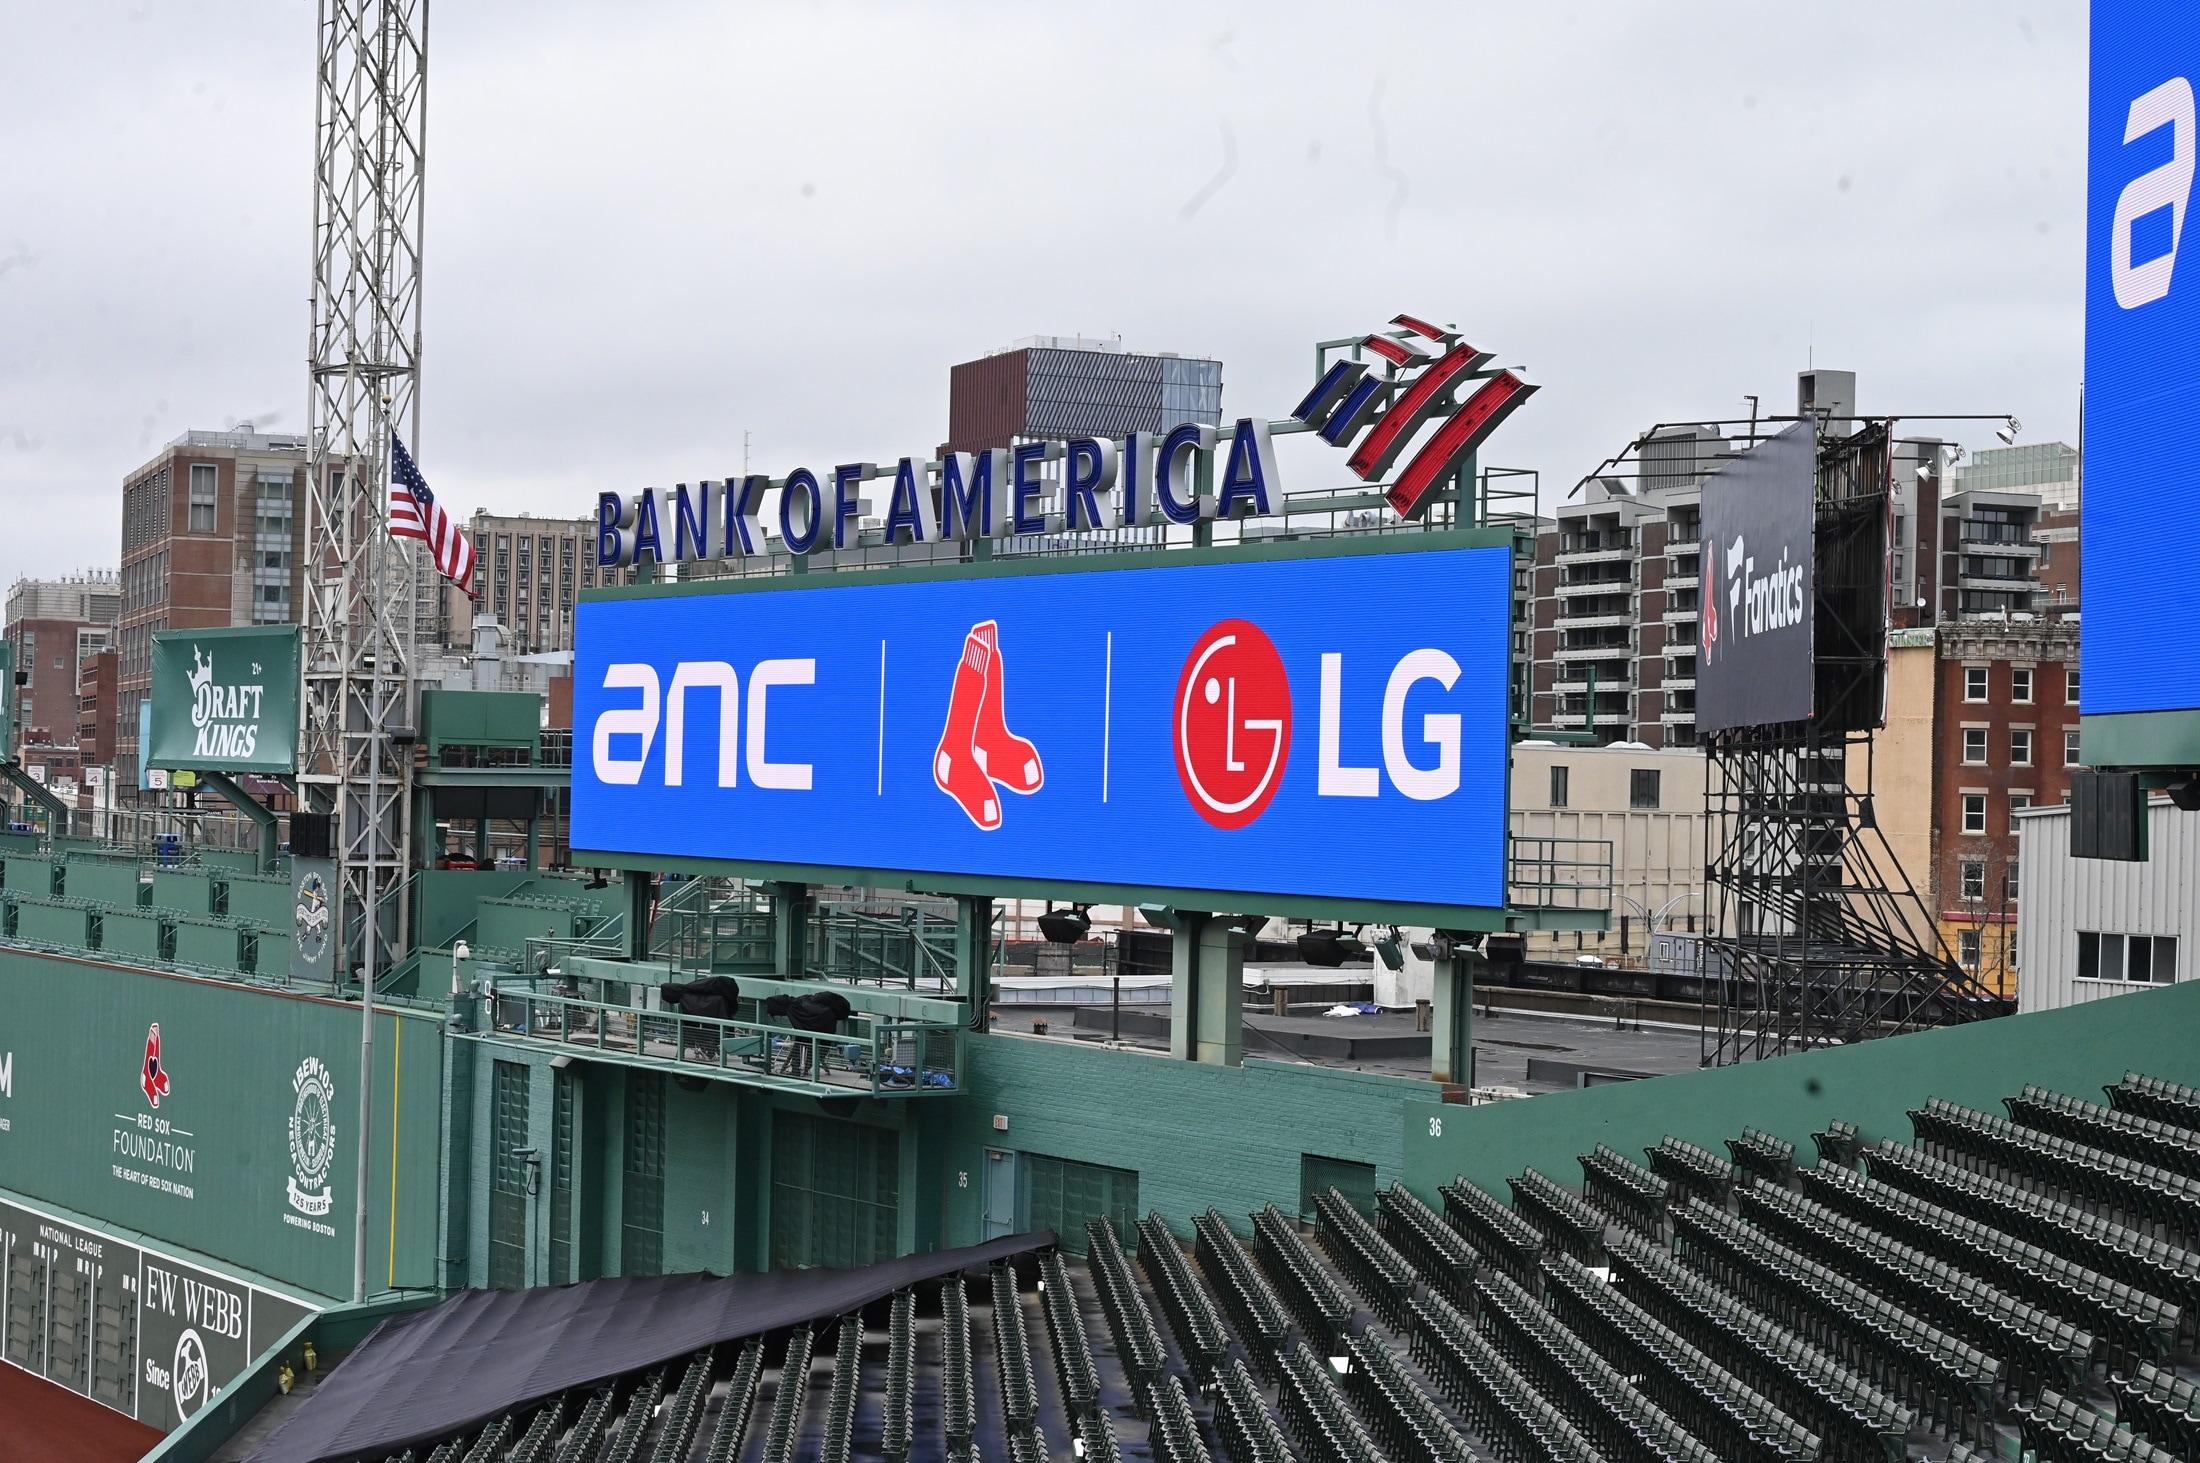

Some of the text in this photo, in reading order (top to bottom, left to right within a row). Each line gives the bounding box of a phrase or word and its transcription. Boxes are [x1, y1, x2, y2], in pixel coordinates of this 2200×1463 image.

[2111, 76, 2196, 310] a
[598, 418, 1286, 568] BANK OF AMERICA
[1744, 545, 1803, 638] Fanatics
[252, 662, 262, 675] 21+
[192, 681, 264, 727] DRAFT
[193, 720, 258, 758] KINGS
[592, 658, 816, 790] anc
[1317, 648, 1462, 800] LG
[33, 772, 41, 781] 3
[90, 775, 98, 784] 4
[154, 777, 163, 786] 5
[138, 1112, 170, 1136] RED SOX
[1429, 1116, 1442, 1138] 36
[113, 1129, 194, 1174] FOUNDATION
[288, 1116, 336, 1191] NECA CONTRACTORS
[112, 1164, 194, 1200] THE HEART OF RED SOX NATION
[958, 1171, 968, 1188] 35
[293, 1192, 327, 1212] 125 YEARS
[701, 1210, 709, 1226] 34
[40, 1224, 103, 1259] NATIONAL LEAGUE
[283, 1213, 336, 1237] POWERING BOSTON
[11, 1233, 16, 1247] P
[40, 1244, 46, 1259] R
[53, 1248, 59, 1262] P
[84, 1260, 90, 1275] R
[97, 1264, 103, 1280] P
[131, 1277, 136, 1293] R
[145, 1265, 242, 1339] F.W. WEBB
[145, 1358, 170, 1390] Since
